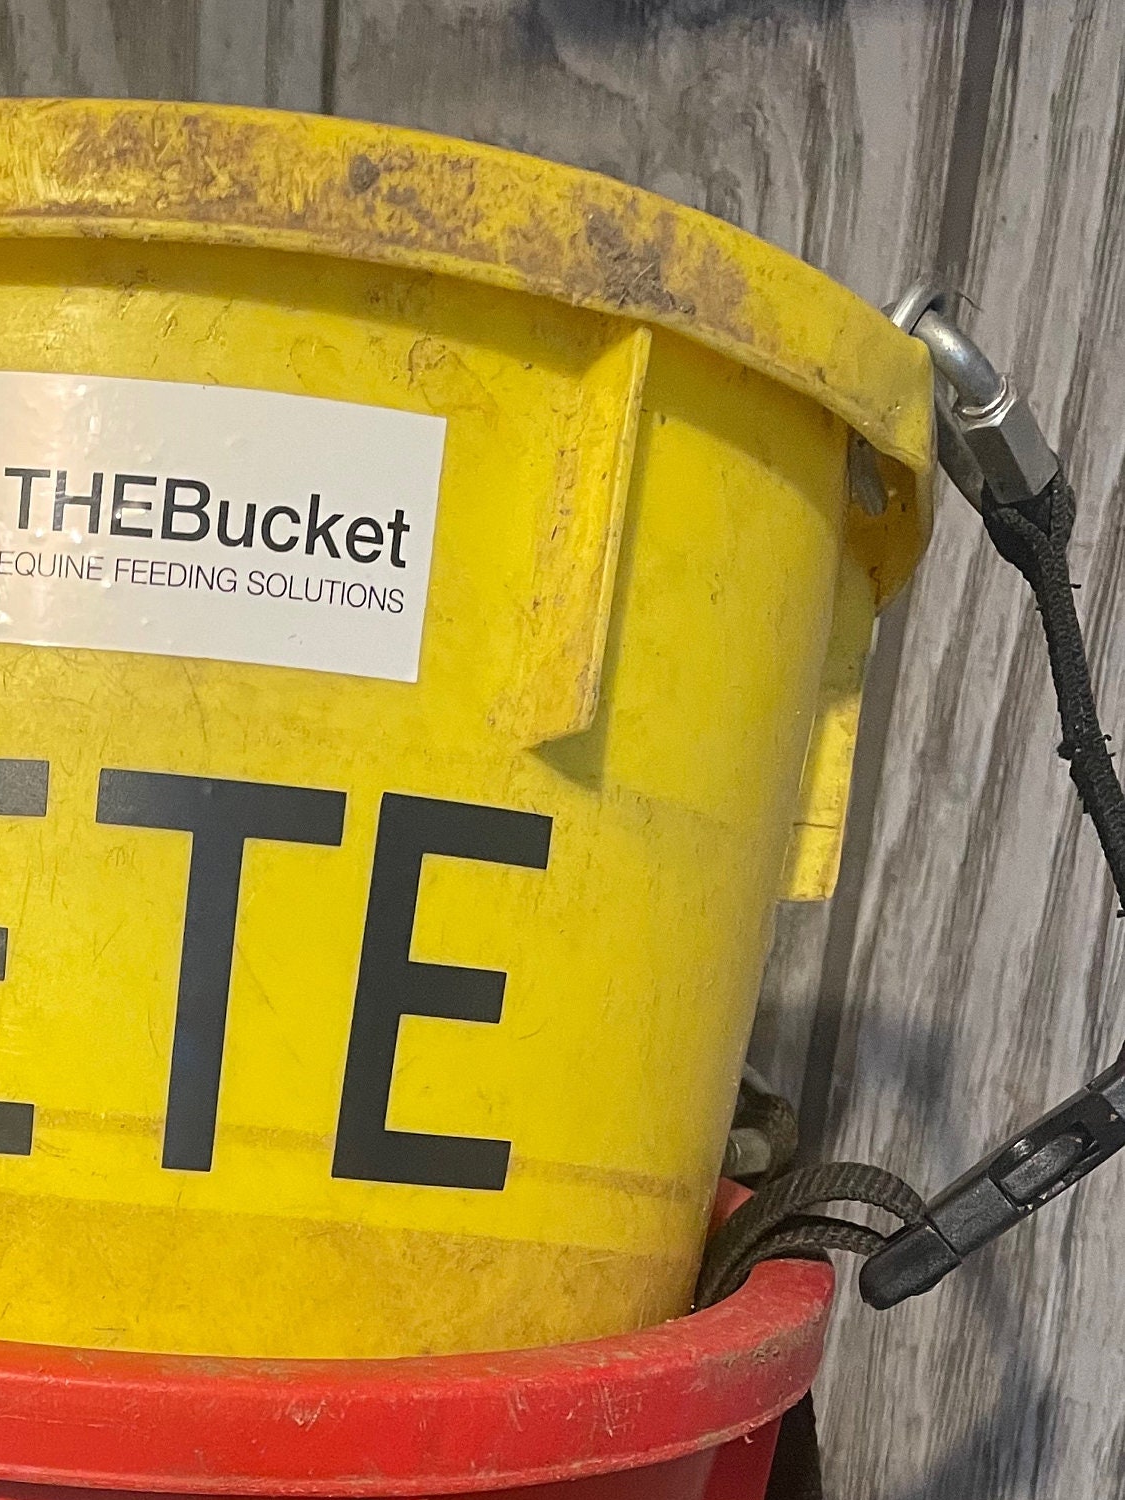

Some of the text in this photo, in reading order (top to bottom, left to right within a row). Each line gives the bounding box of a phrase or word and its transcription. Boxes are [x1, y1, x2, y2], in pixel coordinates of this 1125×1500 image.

[3, 466, 411, 569] THEBucket
[114, 557, 238, 594] FEEDING
[247, 570, 405, 614] SOLUTIONS
